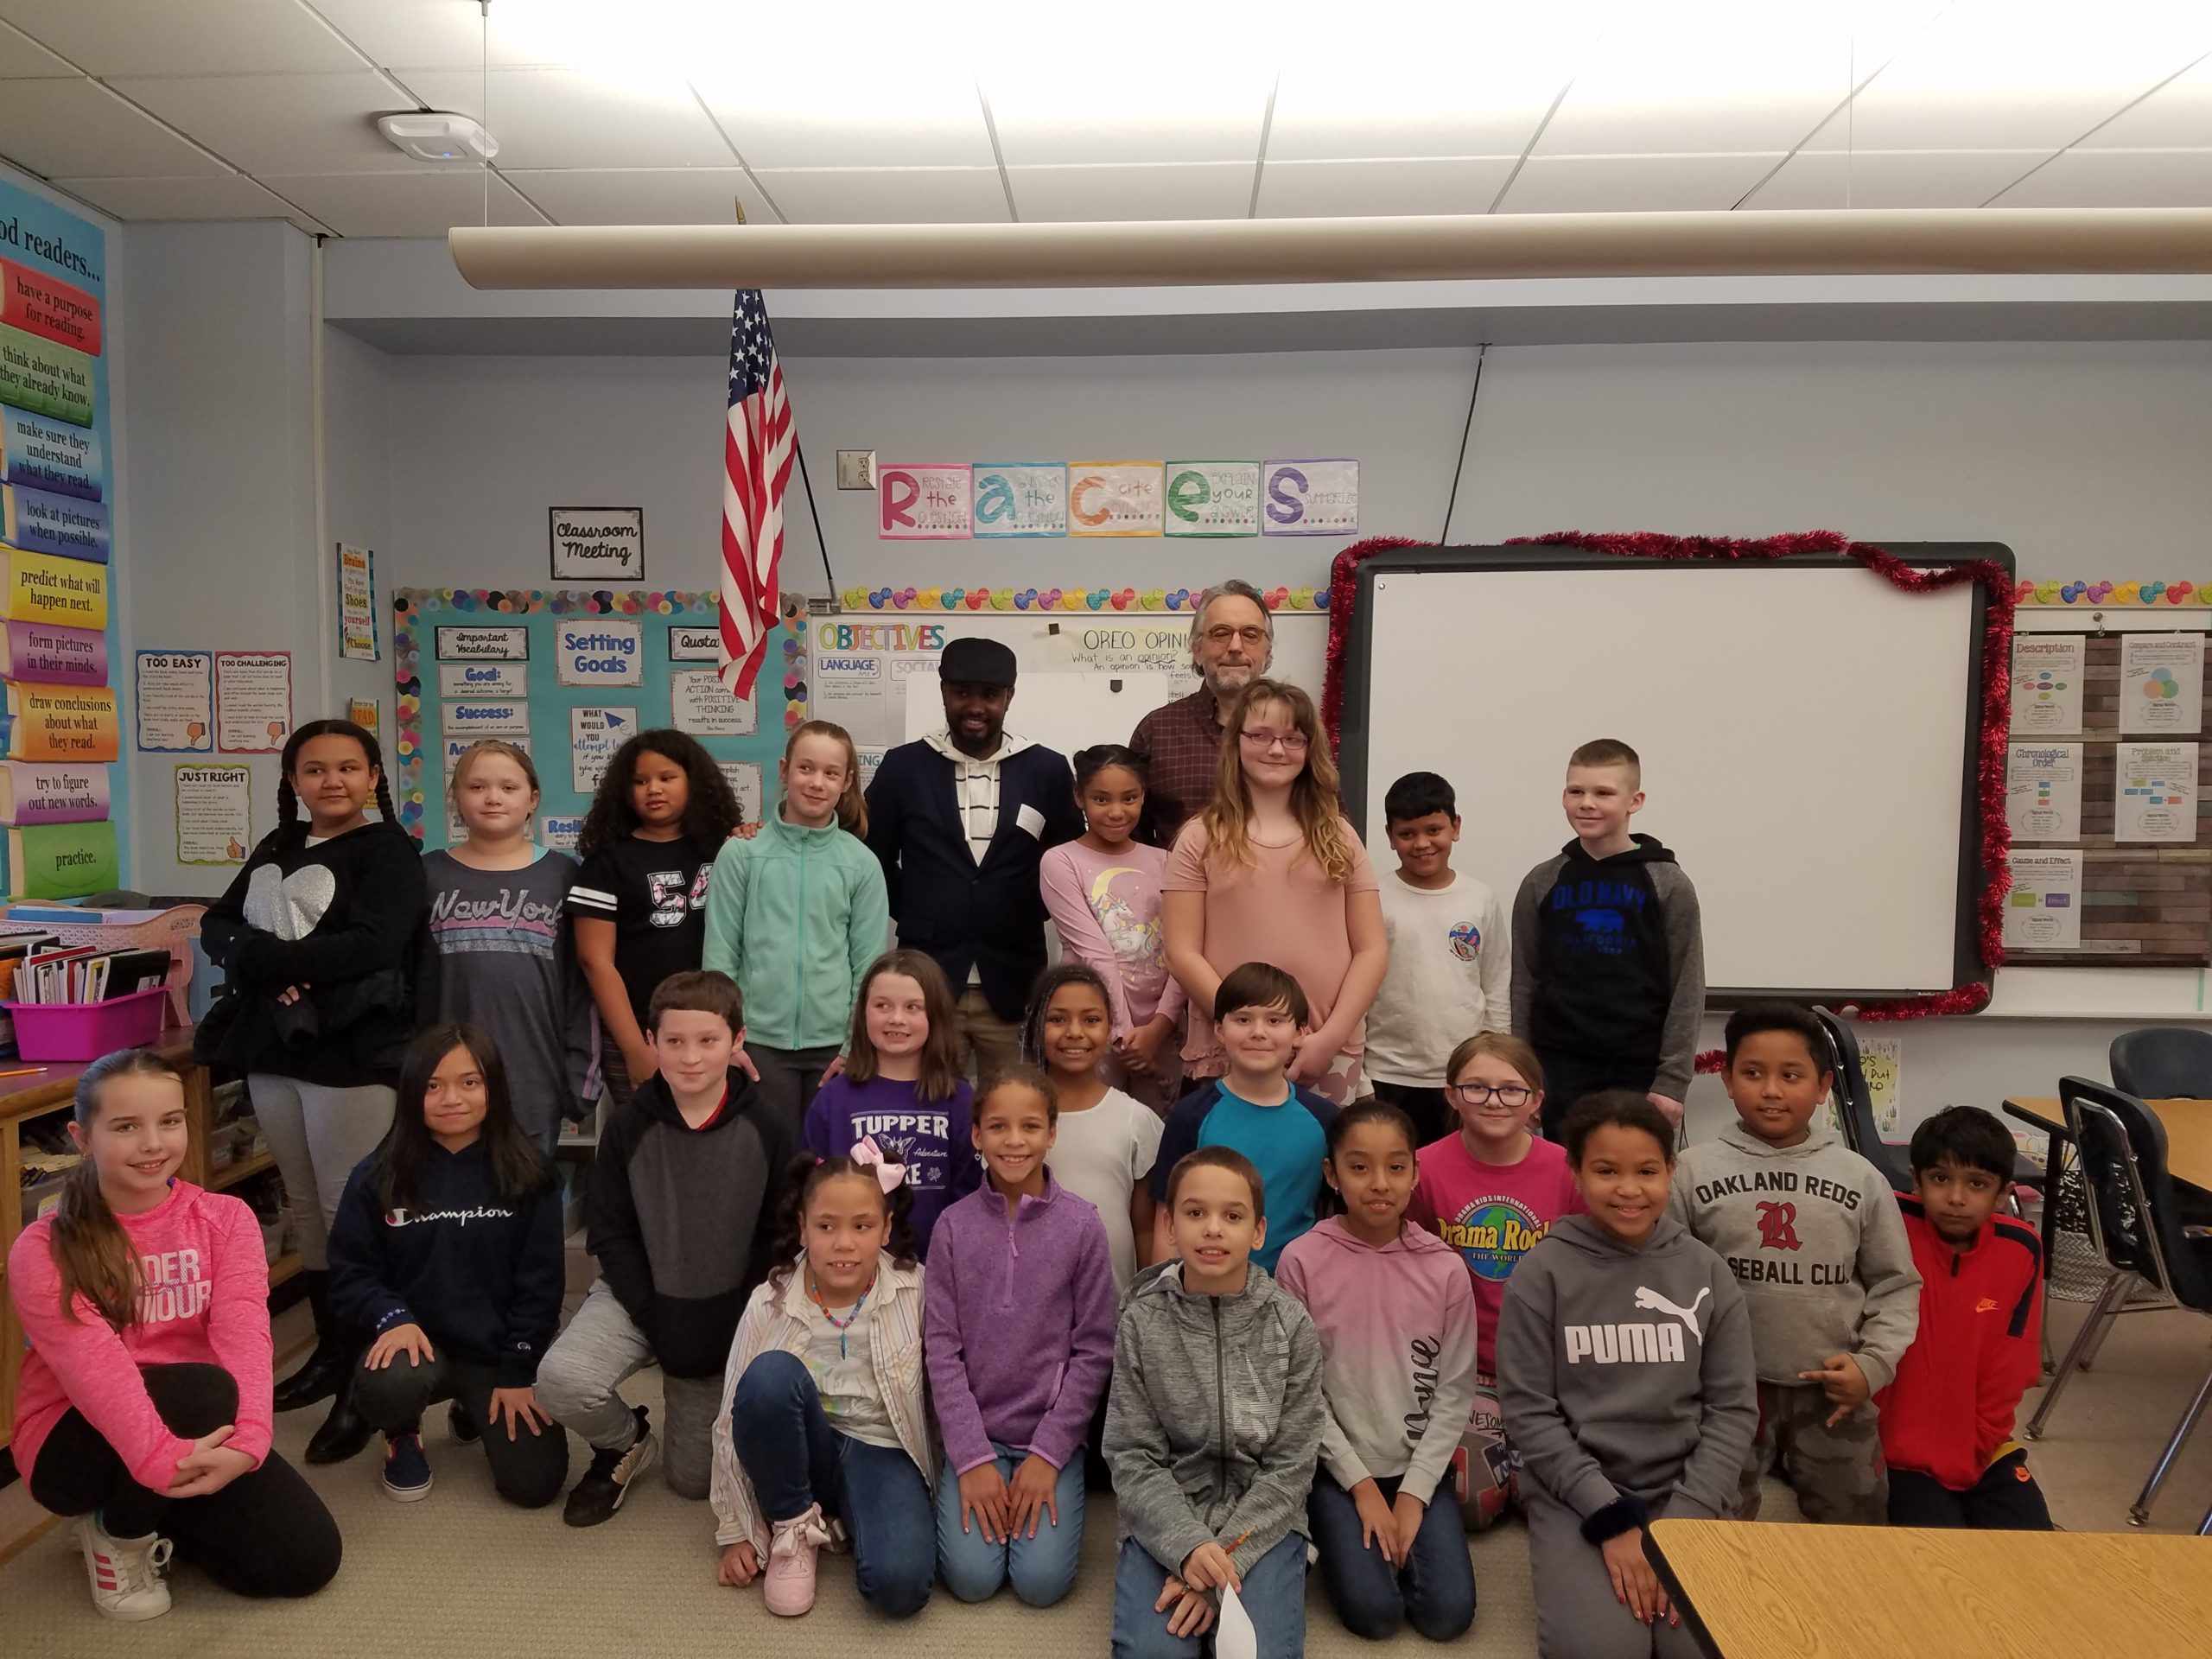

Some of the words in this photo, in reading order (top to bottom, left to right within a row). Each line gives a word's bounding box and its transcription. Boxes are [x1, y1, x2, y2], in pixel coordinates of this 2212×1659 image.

[24, 231, 100, 282] readers...
[16, 276, 41, 304] have
[45, 293, 50, 306] a
[54, 296, 93, 322] purpose
[26, 302, 41, 325] for
[45, 310, 86, 340] reading.
[3, 346, 29, 369] think
[32, 355, 60, 378] about
[63, 365, 86, 387] what
[0, 364, 21, 389] they
[23, 372, 60, 400] already
[62, 385, 91, 407] know.
[17, 420, 43, 439] make
[46, 430, 67, 446] sure
[69, 431, 90, 454] they
[26, 442, 82, 469] understand
[18, 461, 41, 480] what
[44, 464, 65, 488] they
[67, 469, 93, 491] read.
[1025, 489, 1055, 507] the
[1119, 480, 1153, 497] cite
[1168, 470, 1211, 523] e
[1266, 467, 1309, 524] S
[882, 472, 920, 531] R
[926, 491, 957, 508] the
[976, 474, 1016, 524] a
[26, 499, 48, 520] look
[50, 506, 60, 521] at
[62, 507, 100, 532] pictures
[29, 522, 56, 541] when
[58, 528, 99, 550] possible.
[556, 522, 638, 538] Classroom
[563, 541, 632, 566] Meeting
[21, 569, 58, 591] predict
[60, 575, 84, 592] what
[86, 577, 101, 594] will
[29, 588, 67, 612] happen
[70, 597, 93, 613] next.
[344, 615, 370, 626] yourself
[29, 632, 53, 649] form
[56, 634, 93, 656] pictures
[456, 632, 509, 645] Important
[564, 632, 636, 656] Setting
[819, 623, 945, 651] OBJECTIVES
[1084, 630, 1135, 650] OREO
[1145, 632, 1189, 649] OPINI
[456, 643, 510, 657] Vocabulary
[1071, 652, 1098, 664] What
[1105, 652, 1113, 663] is
[1120, 653, 1132, 663] an
[1138, 650, 1179, 664] opinion?
[2016, 643, 2075, 654] Description
[27, 652, 38, 669] in
[41, 654, 62, 671] their
[65, 657, 98, 674] minds.
[146, 658, 168, 668] TOO
[173, 659, 202, 669] EASY
[574, 656, 627, 673] Goals
[820, 659, 875, 671] LANGUAGE
[1094, 663, 1105, 671] An
[1110, 663, 1140, 672] opinion
[1147, 663, 1154, 671] is
[1158, 662, 1175, 671] how
[465, 667, 501, 682] Goal:
[1170, 671, 1192, 679] feels
[29, 693, 52, 710] draw
[54, 695, 112, 713] conclusions
[455, 706, 514, 719] Success:
[45, 715, 71, 730] about
[73, 716, 99, 732] what
[582, 709, 602, 718] WHAT
[49, 733, 69, 752] they
[71, 733, 96, 750] read.
[574, 738, 610, 753] attempt
[591, 754, 605, 763] you
[2016, 749, 2069, 759] Chronological
[2032, 759, 2056, 768] Order
[35, 775, 50, 794] try
[52, 776, 61, 791] to
[63, 774, 90, 794] figure
[179, 772, 208, 782] JUST
[210, 772, 245, 782] RIGHT
[29, 796, 45, 811] out
[47, 798, 65, 811] new
[67, 793, 99, 810] words.
[55, 850, 97, 872] practice.
[1552, 880, 1594, 910] OLD
[1597, 881, 1648, 913] NAVY
[429, 889, 500, 925] New
[850, 1115, 950, 1141] TUPPER
[913, 1147, 949, 1158] Adventure
[1694, 1171, 1798, 1205] OAKLAND
[1806, 1175, 1862, 1211] REDS
[1454, 1202, 1476, 1224] DRAMA
[1474, 1195, 1493, 1205] KIDS
[1493, 1194, 1542, 1228] INTERNATIONAL
[1472, 1252, 1491, 1261] THE
[1564, 1322, 1686, 1364] PUMA
